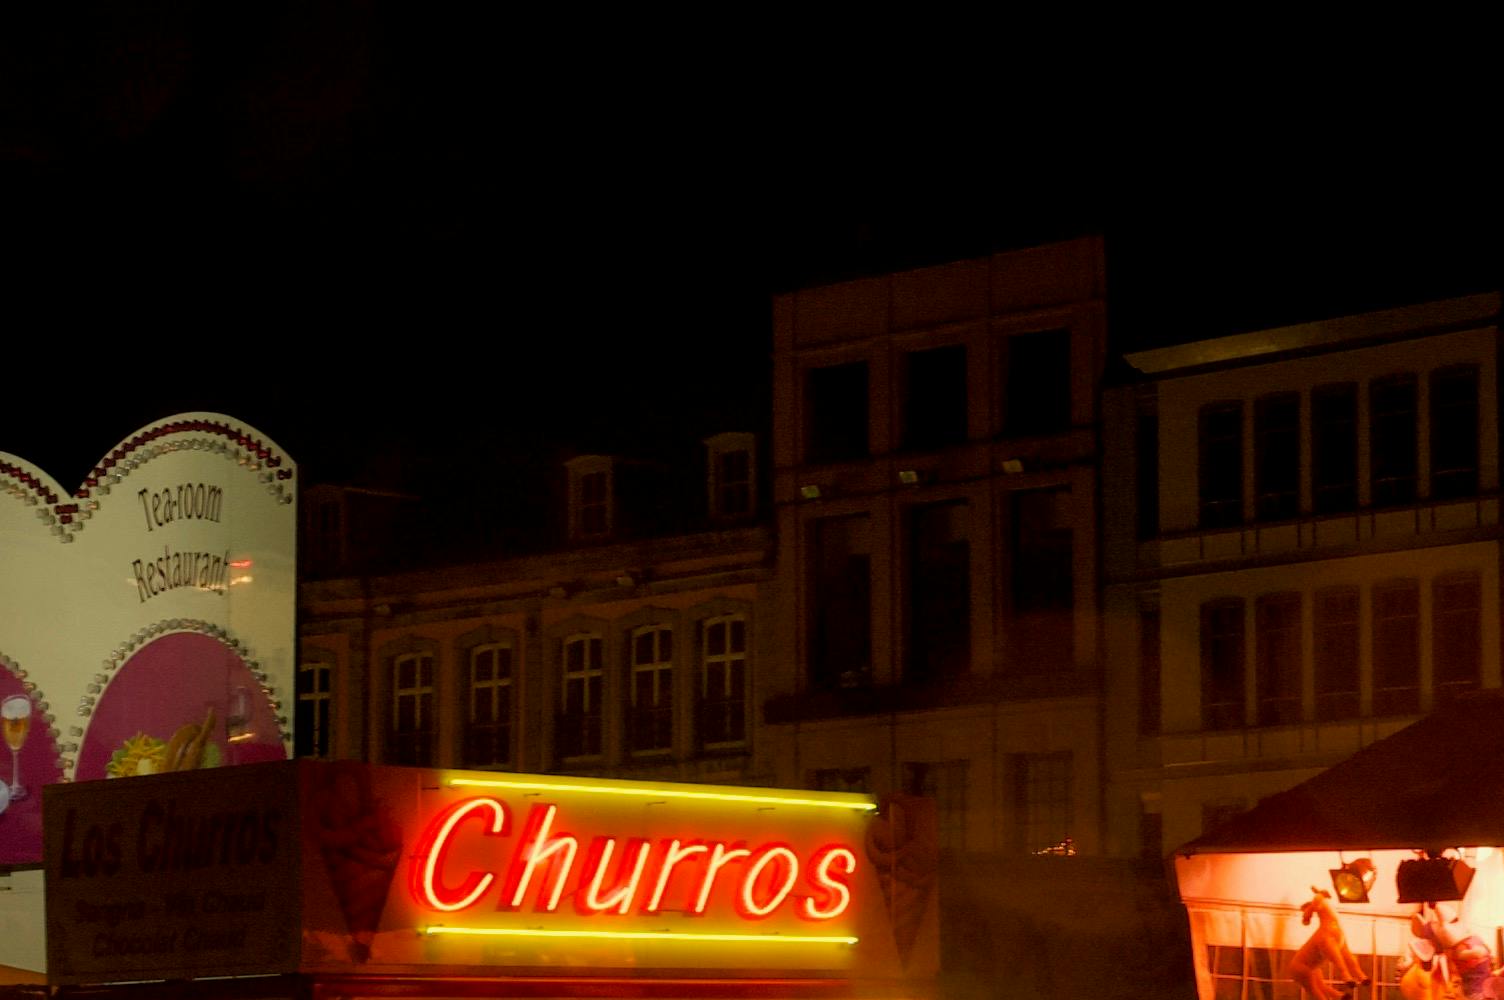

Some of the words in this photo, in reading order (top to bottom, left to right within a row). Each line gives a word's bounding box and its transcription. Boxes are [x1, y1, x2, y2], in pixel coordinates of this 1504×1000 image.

[137, 482, 223, 531] Tea-room
[132, 545, 231, 603] Restaurant
[61, 808, 123, 878] Los
[137, 798, 282, 873] Churros
[409, 796, 858, 921] Churros
